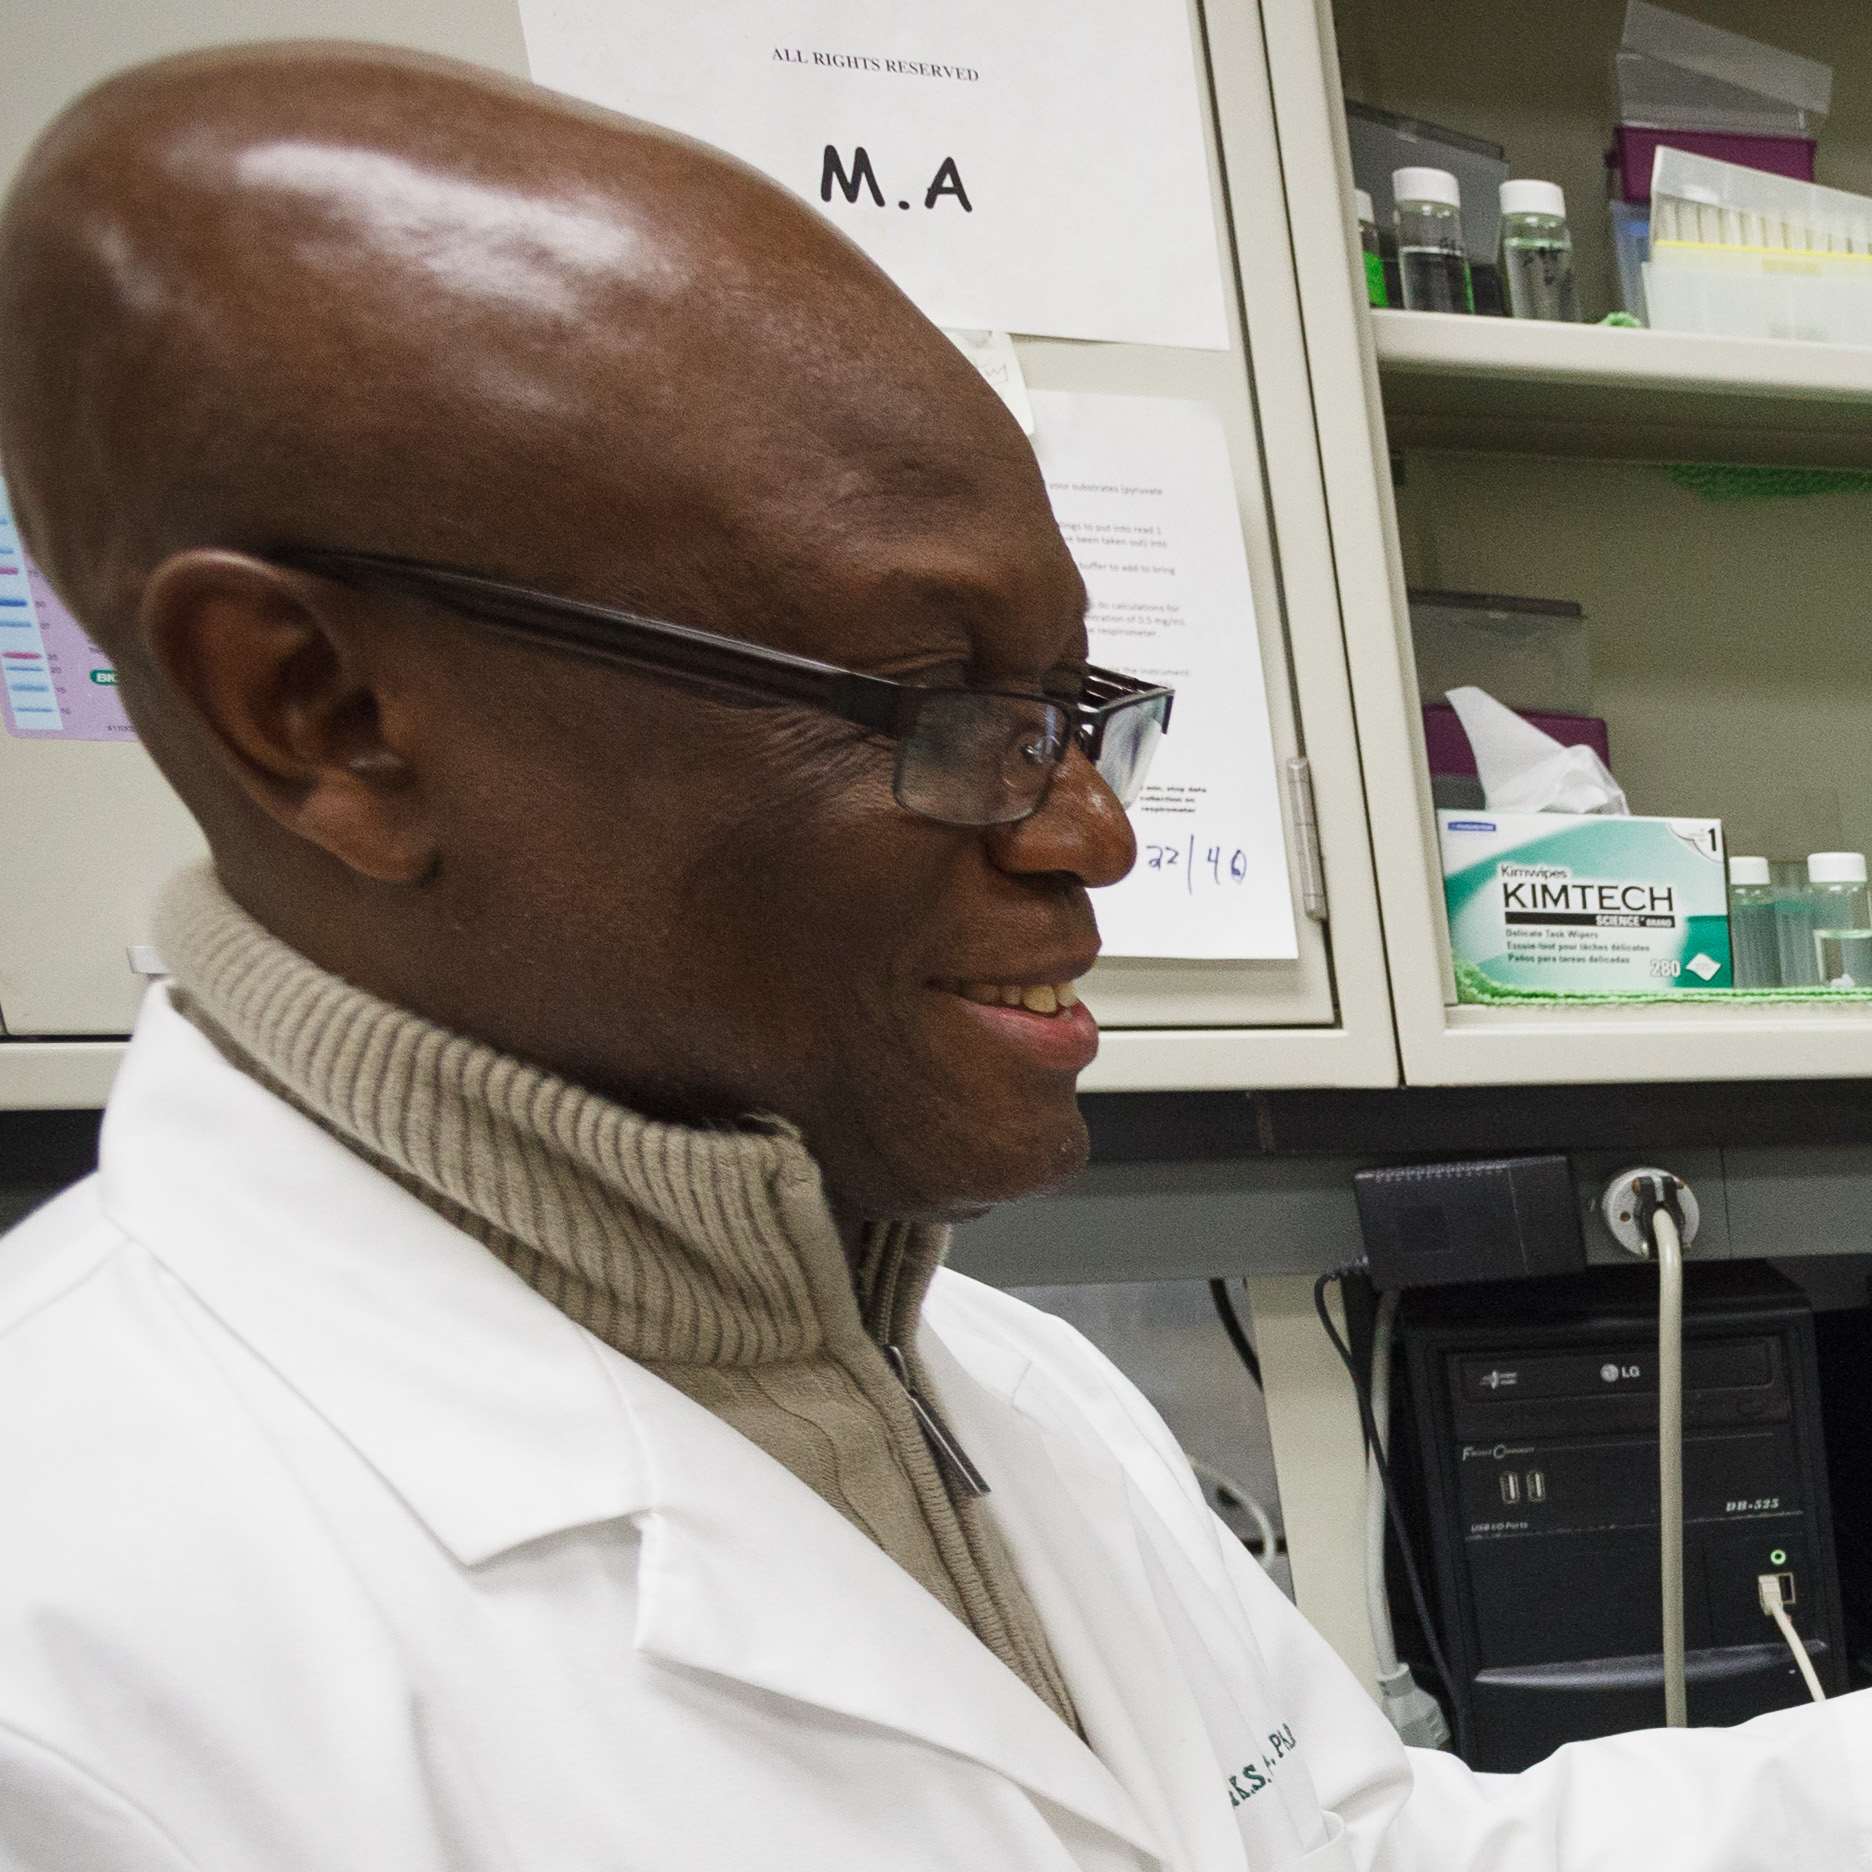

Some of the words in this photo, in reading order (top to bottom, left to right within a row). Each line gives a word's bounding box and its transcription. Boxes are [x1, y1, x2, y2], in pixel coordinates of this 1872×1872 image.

[772, 48, 808, 64] ALL
[812, 52, 880, 72] RIGHTS
[885, 60, 979, 81] RESERVED
[1500, 865, 1568, 879] Kimwipes
[1502, 883, 1673, 912] KIMTECH
[1568, 930, 1598, 940] Wipers
[1651, 961, 1680, 977] 280
[1621, 1365, 1640, 1378] LG
